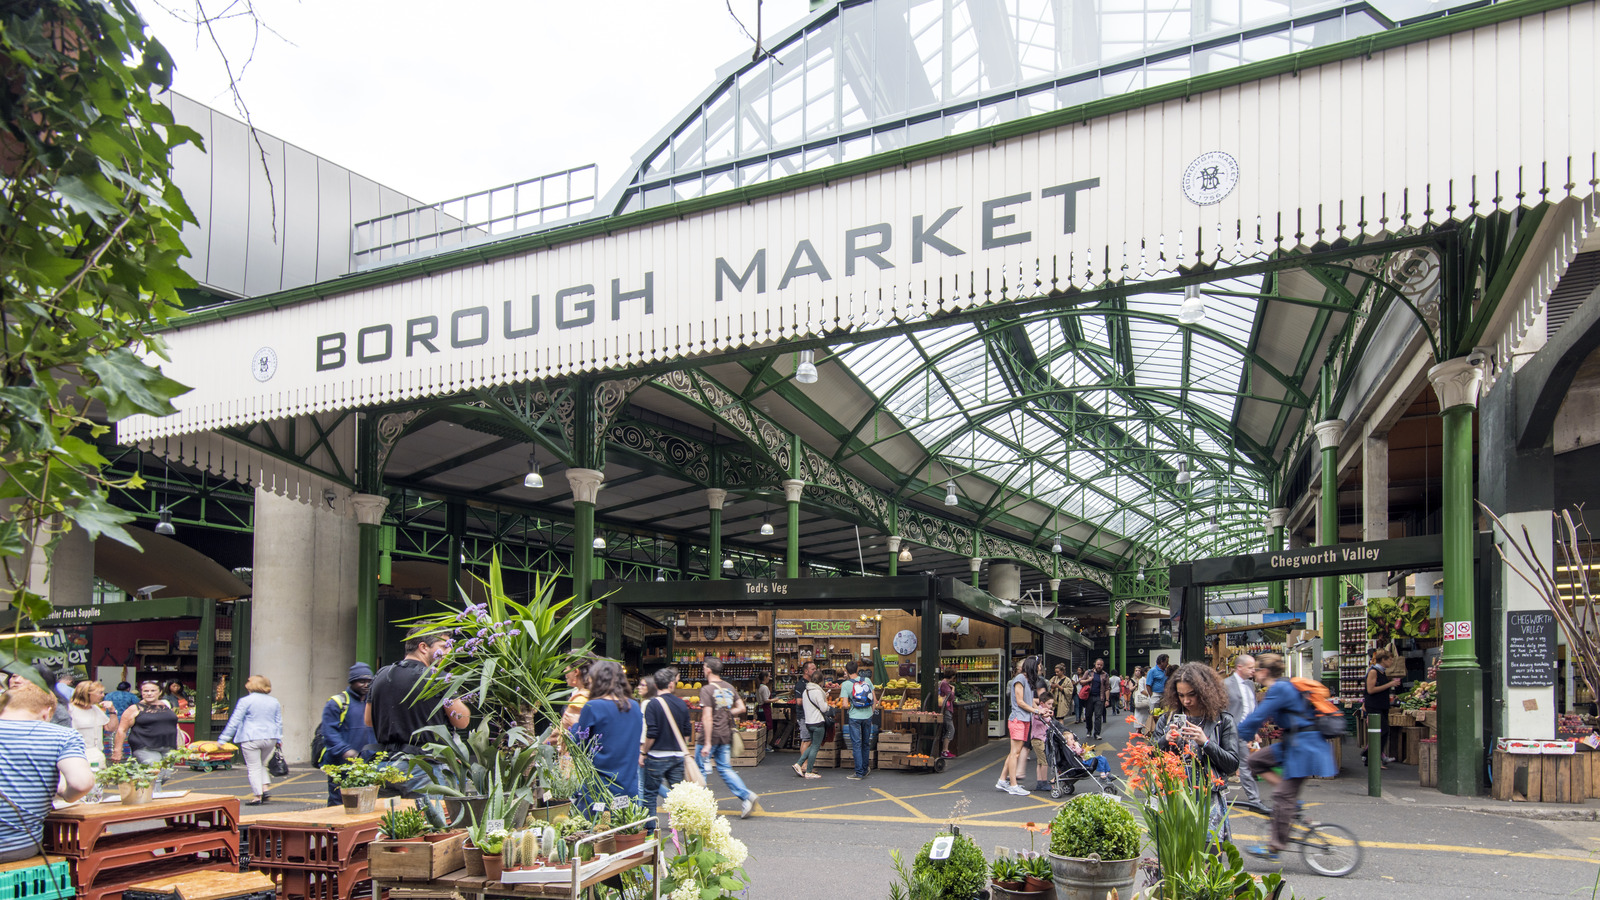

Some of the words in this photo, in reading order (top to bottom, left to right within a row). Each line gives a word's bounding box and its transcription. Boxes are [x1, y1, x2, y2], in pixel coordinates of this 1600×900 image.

[316, 271, 654, 372] BOROUGH
[715, 176, 1100, 302] MARKET
[1270, 549, 1337, 568] Chegworth
[1341, 546, 1380, 561] Valley
[746, 582, 768, 593] Ted's
[771, 582, 788, 595] Veg
[62, 609, 77, 619] Fresh
[78, 607, 101, 619] Supplies
[1511, 614, 1552, 625] CHEGWORTH
[831, 621, 851, 631] VEG
[1521, 625, 1544, 634] VALLEY
